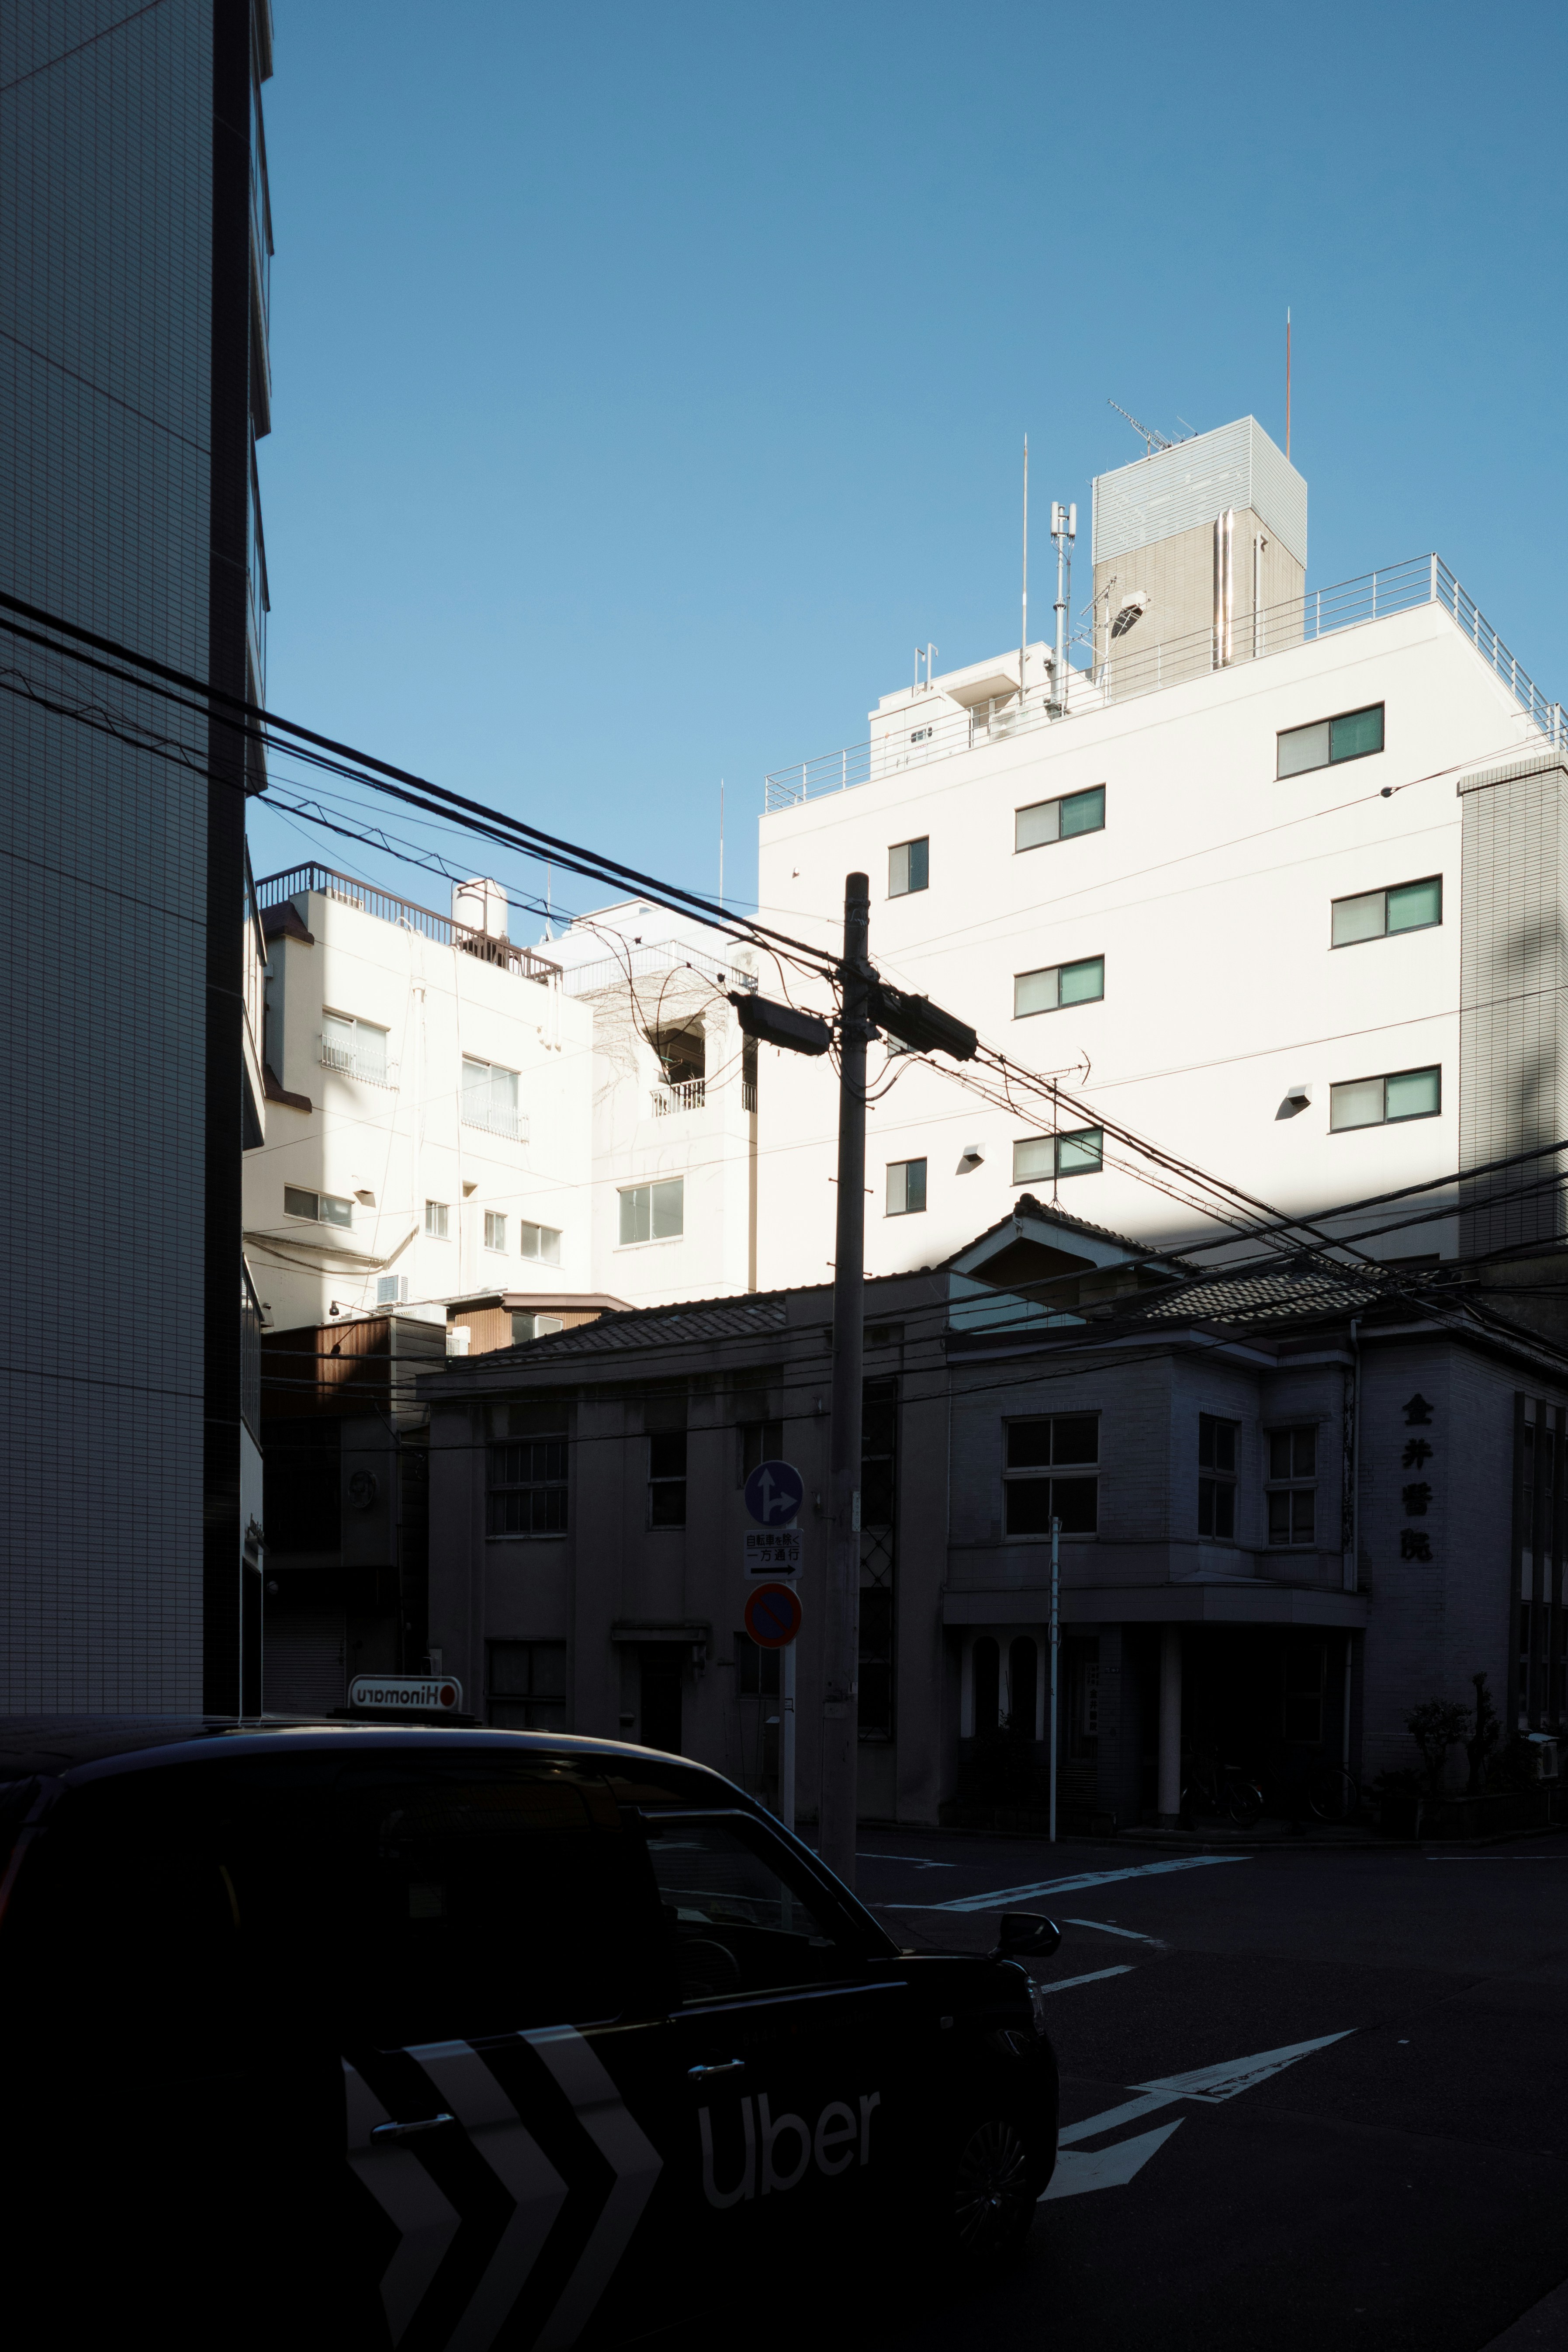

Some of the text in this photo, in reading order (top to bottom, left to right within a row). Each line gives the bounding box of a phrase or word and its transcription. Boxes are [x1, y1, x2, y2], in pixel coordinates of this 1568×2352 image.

[747, 1533, 799, 1546] 自転車を除く
[747, 1548, 799, 1561] 一方通行
[698, 2090, 881, 2209] Uber
